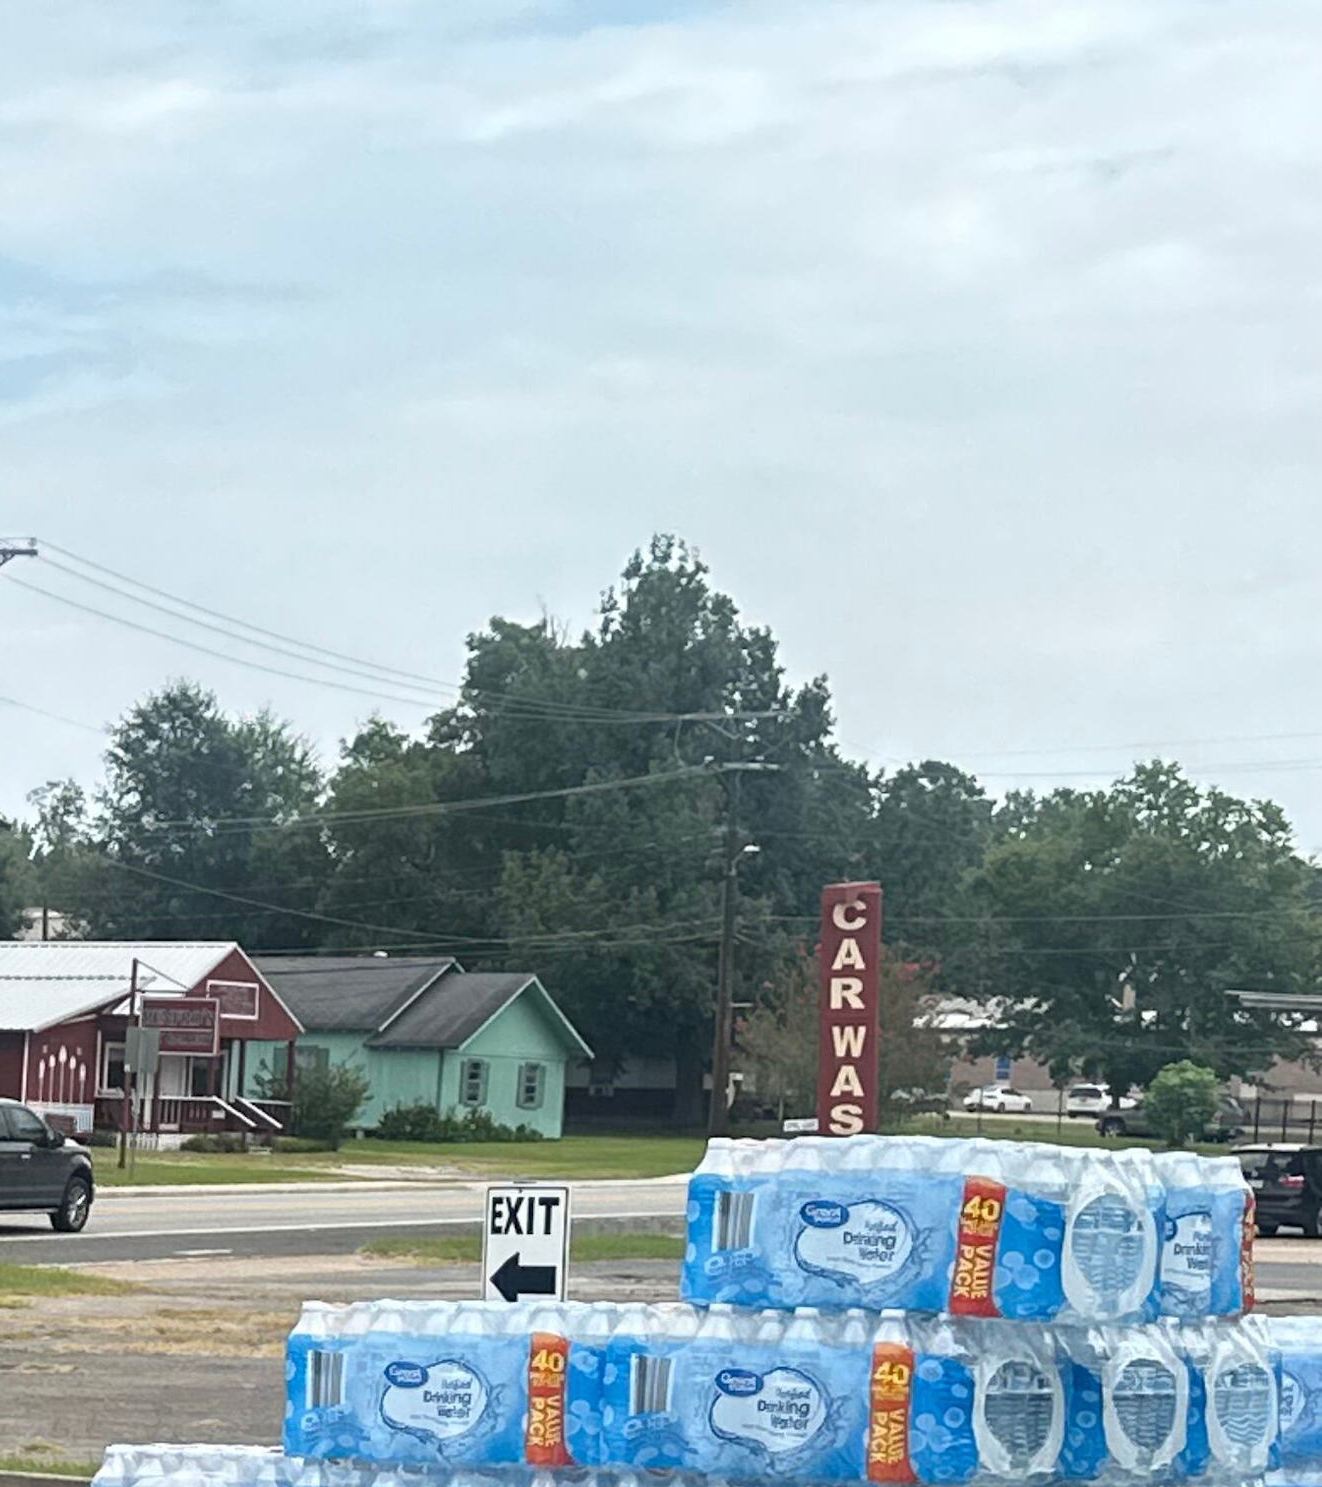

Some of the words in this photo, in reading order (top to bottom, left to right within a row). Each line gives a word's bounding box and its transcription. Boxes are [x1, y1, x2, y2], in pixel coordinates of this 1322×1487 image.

[829, 899, 867, 1010] CAR
[829, 1024, 867, 1136] WAS
[491, 1196, 560, 1235] EXIT
[964, 1196, 1000, 1220] 40
[954, 1245, 974, 1297] PACK
[972, 1245, 992, 1298] VALUE
[532, 1349, 564, 1371] 40
[875, 1362, 909, 1386] 40
[527, 1397, 544, 1446] PACK
[545, 1396, 560, 1447] VALUE
[869, 1412, 887, 1463] PACK
[888, 1409, 905, 1464] VALUE
